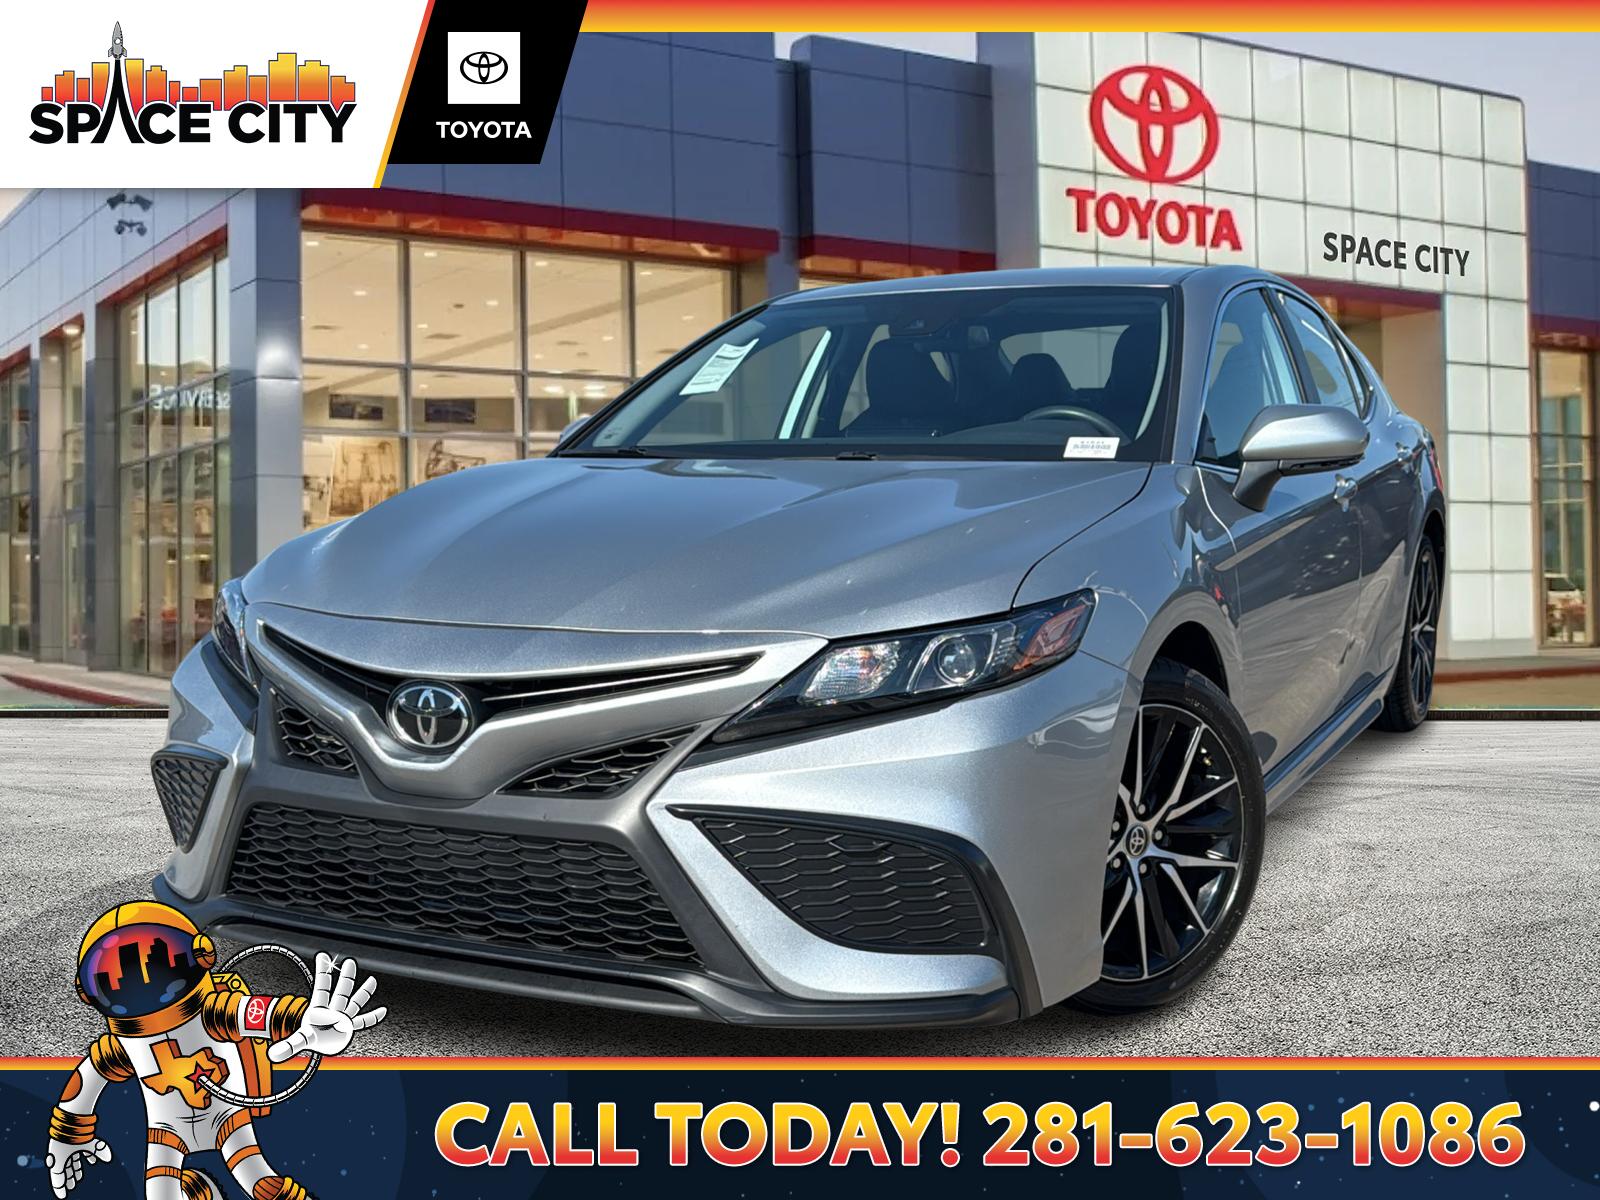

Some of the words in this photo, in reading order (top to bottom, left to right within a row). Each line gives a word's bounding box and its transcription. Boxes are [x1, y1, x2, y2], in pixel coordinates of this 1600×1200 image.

[1065, 188, 1242, 251] TOYOTA
[1323, 232, 1407, 270] SPACE
[1414, 244, 1470, 277] CITY
